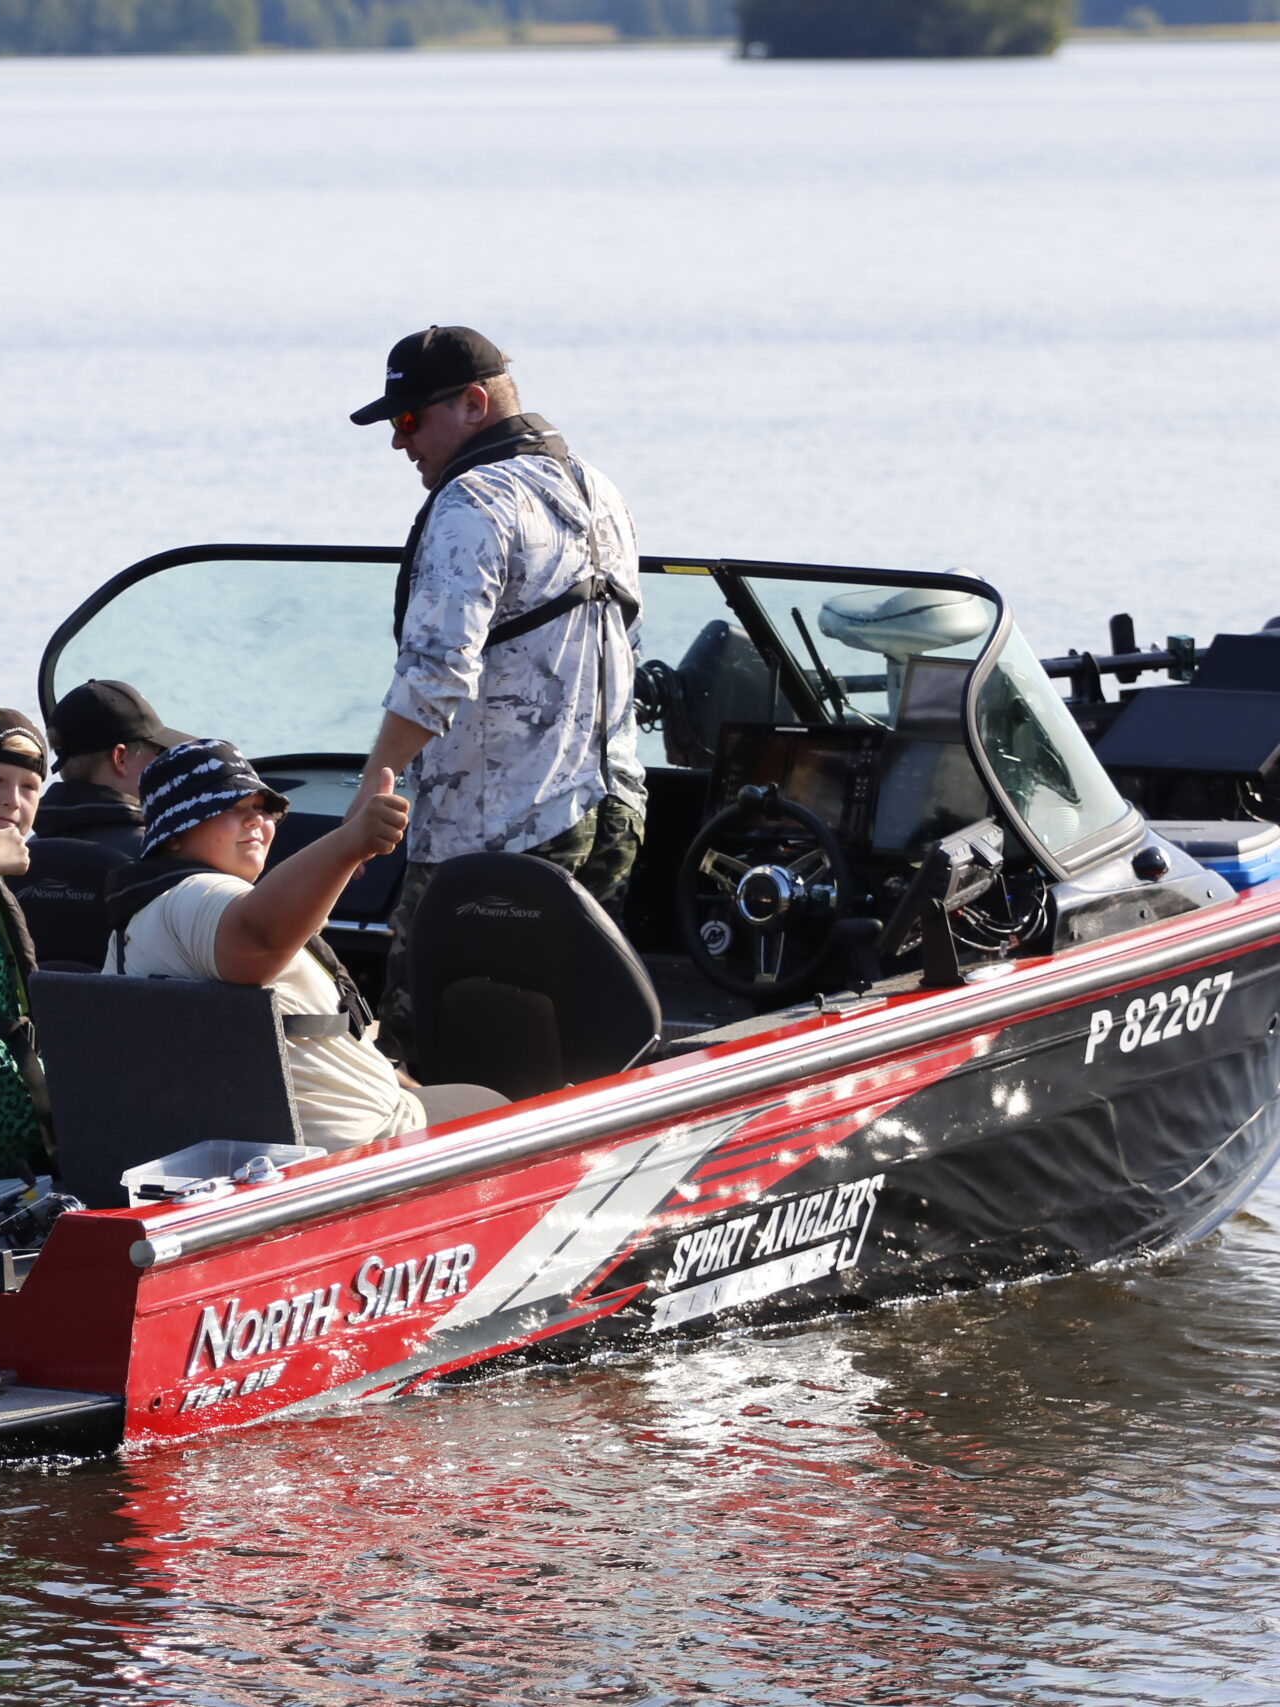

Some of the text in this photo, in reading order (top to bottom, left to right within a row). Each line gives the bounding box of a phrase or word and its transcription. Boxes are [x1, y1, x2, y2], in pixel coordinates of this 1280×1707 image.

[473, 904, 508, 917] NORTH
[1084, 971, 1234, 1065] P 82267
[664, 1173, 886, 1290] SPORT ANGLERS
[186, 1243, 477, 1378] NORTH SILVER
